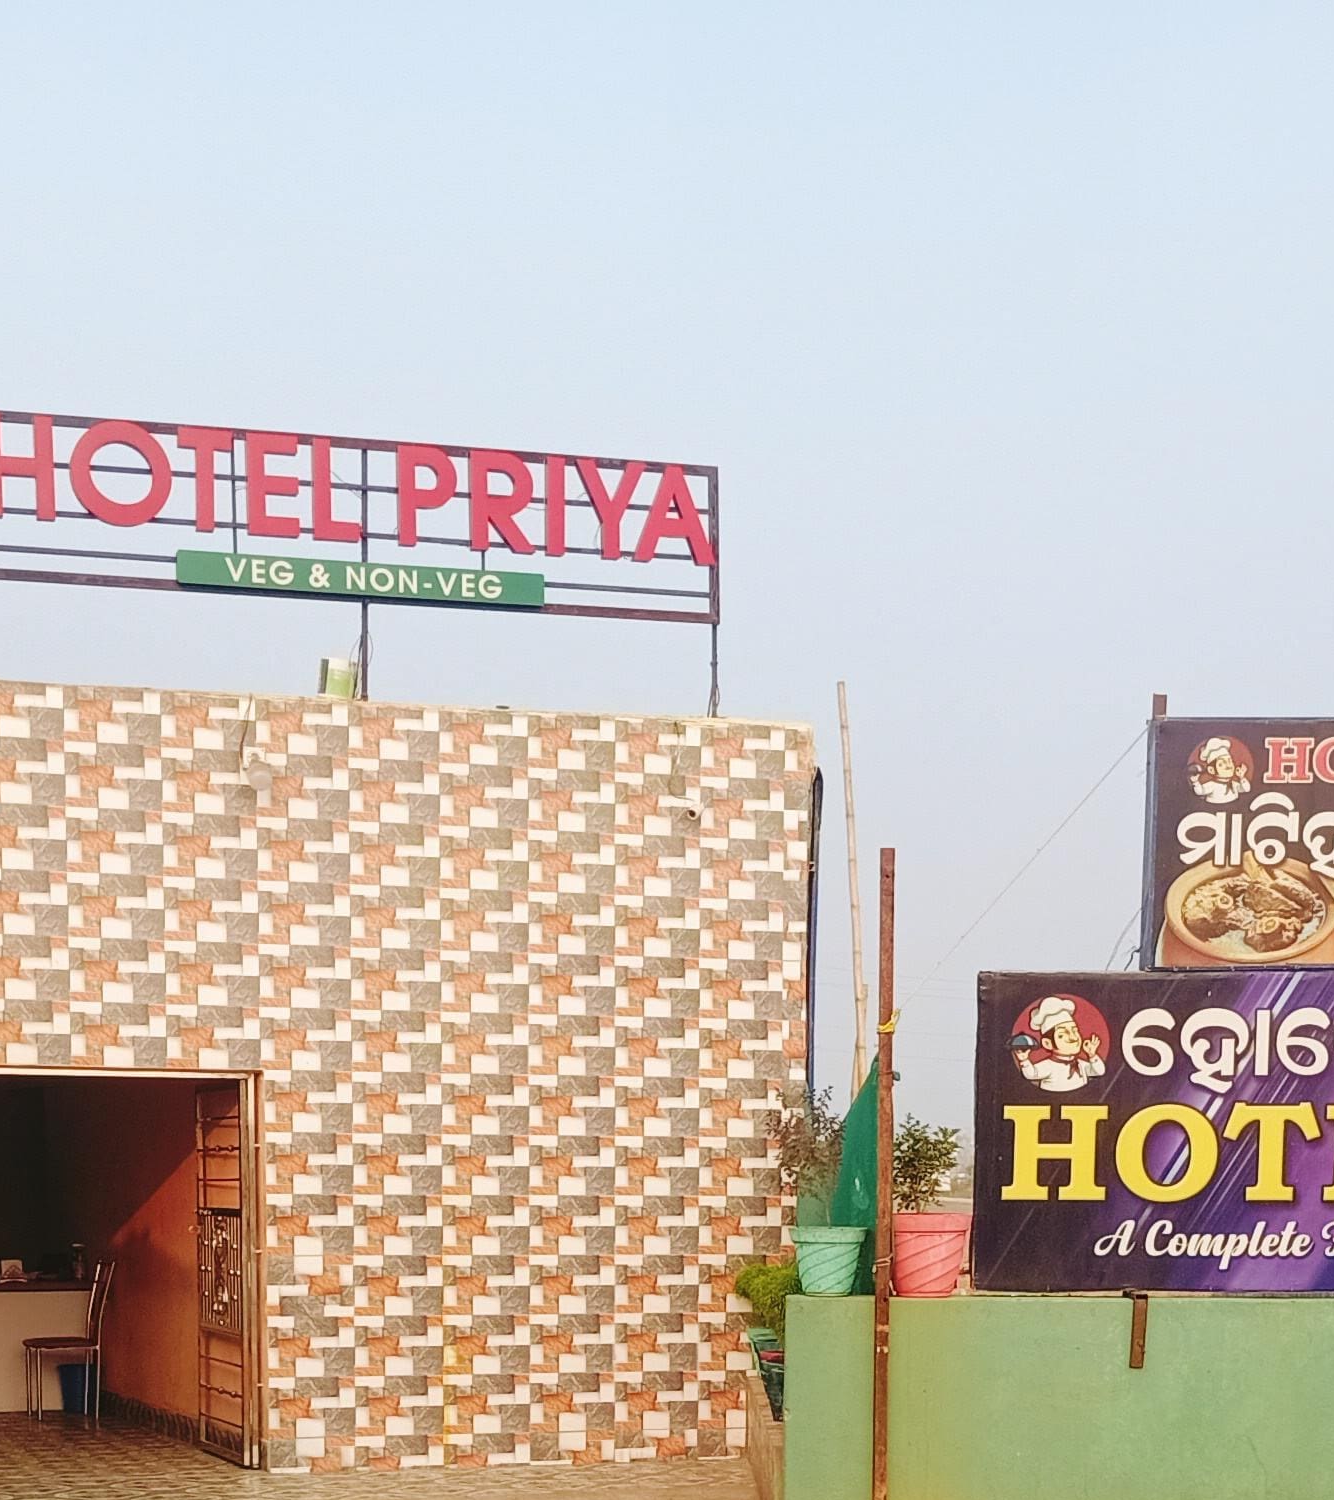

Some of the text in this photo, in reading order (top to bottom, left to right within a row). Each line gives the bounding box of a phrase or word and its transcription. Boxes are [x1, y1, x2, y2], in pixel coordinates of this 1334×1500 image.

[396, 444, 715, 566] PRIYA
[225, 557, 503, 599] VEG & NON-VEG
[1093, 1219, 1137, 1257] A
[1144, 1219, 1313, 1270] Complete
